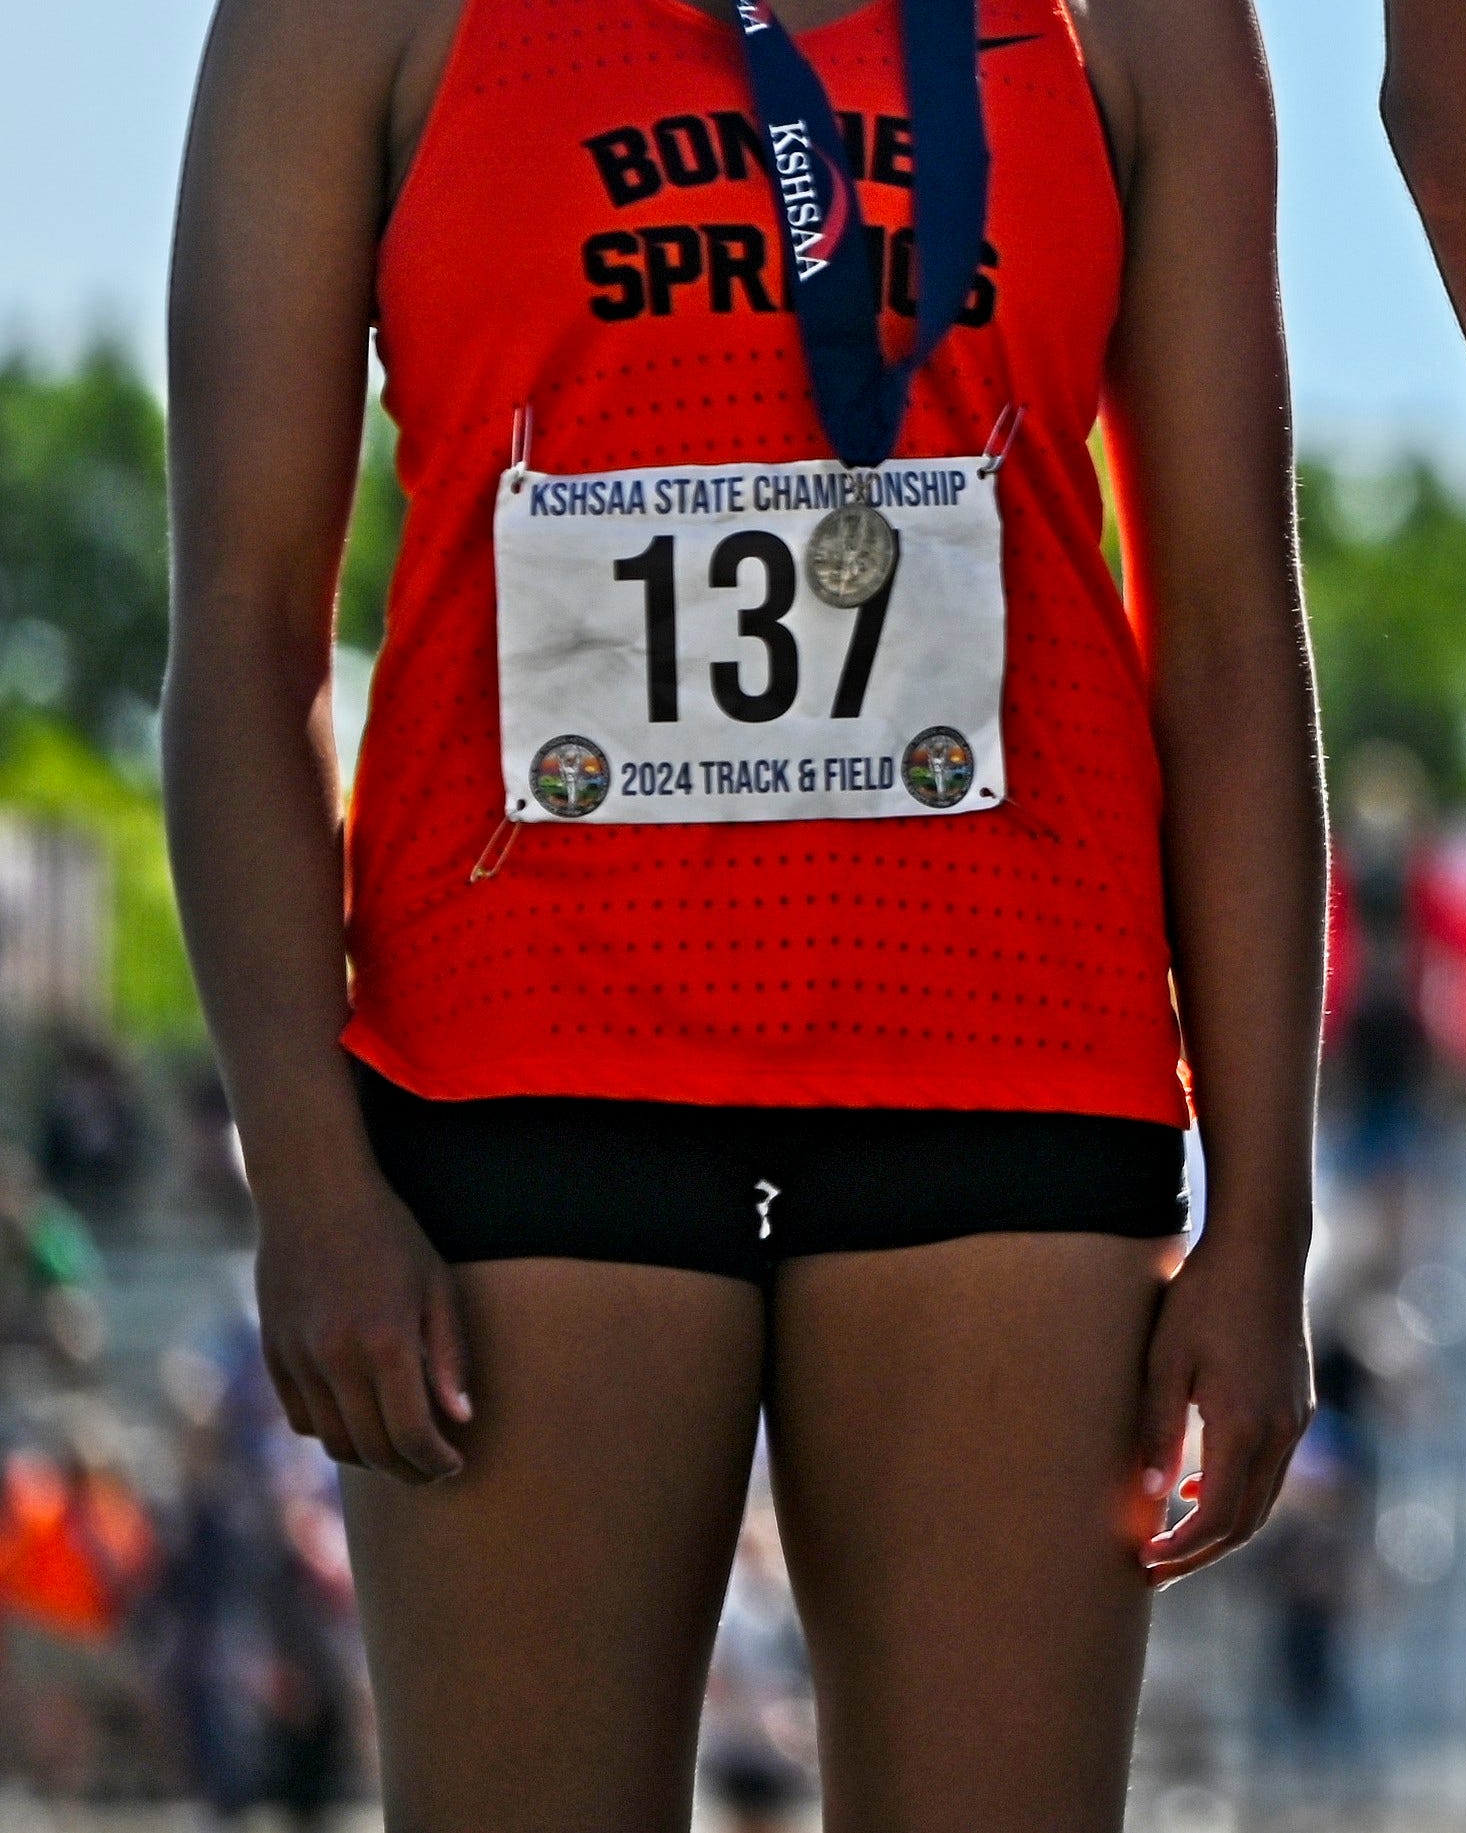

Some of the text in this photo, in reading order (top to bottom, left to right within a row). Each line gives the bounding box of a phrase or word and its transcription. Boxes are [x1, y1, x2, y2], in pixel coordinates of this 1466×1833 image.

[769, 120, 829, 281] KSHSAA
[530, 480, 645, 516] KSHSAA
[655, 476, 744, 513] STATE
[613, 529, 900, 723] 137
[621, 762, 692, 796] 2024
[699, 760, 790, 794] TRACK
[799, 759, 816, 792] &
[824, 756, 894, 791] FIELD
